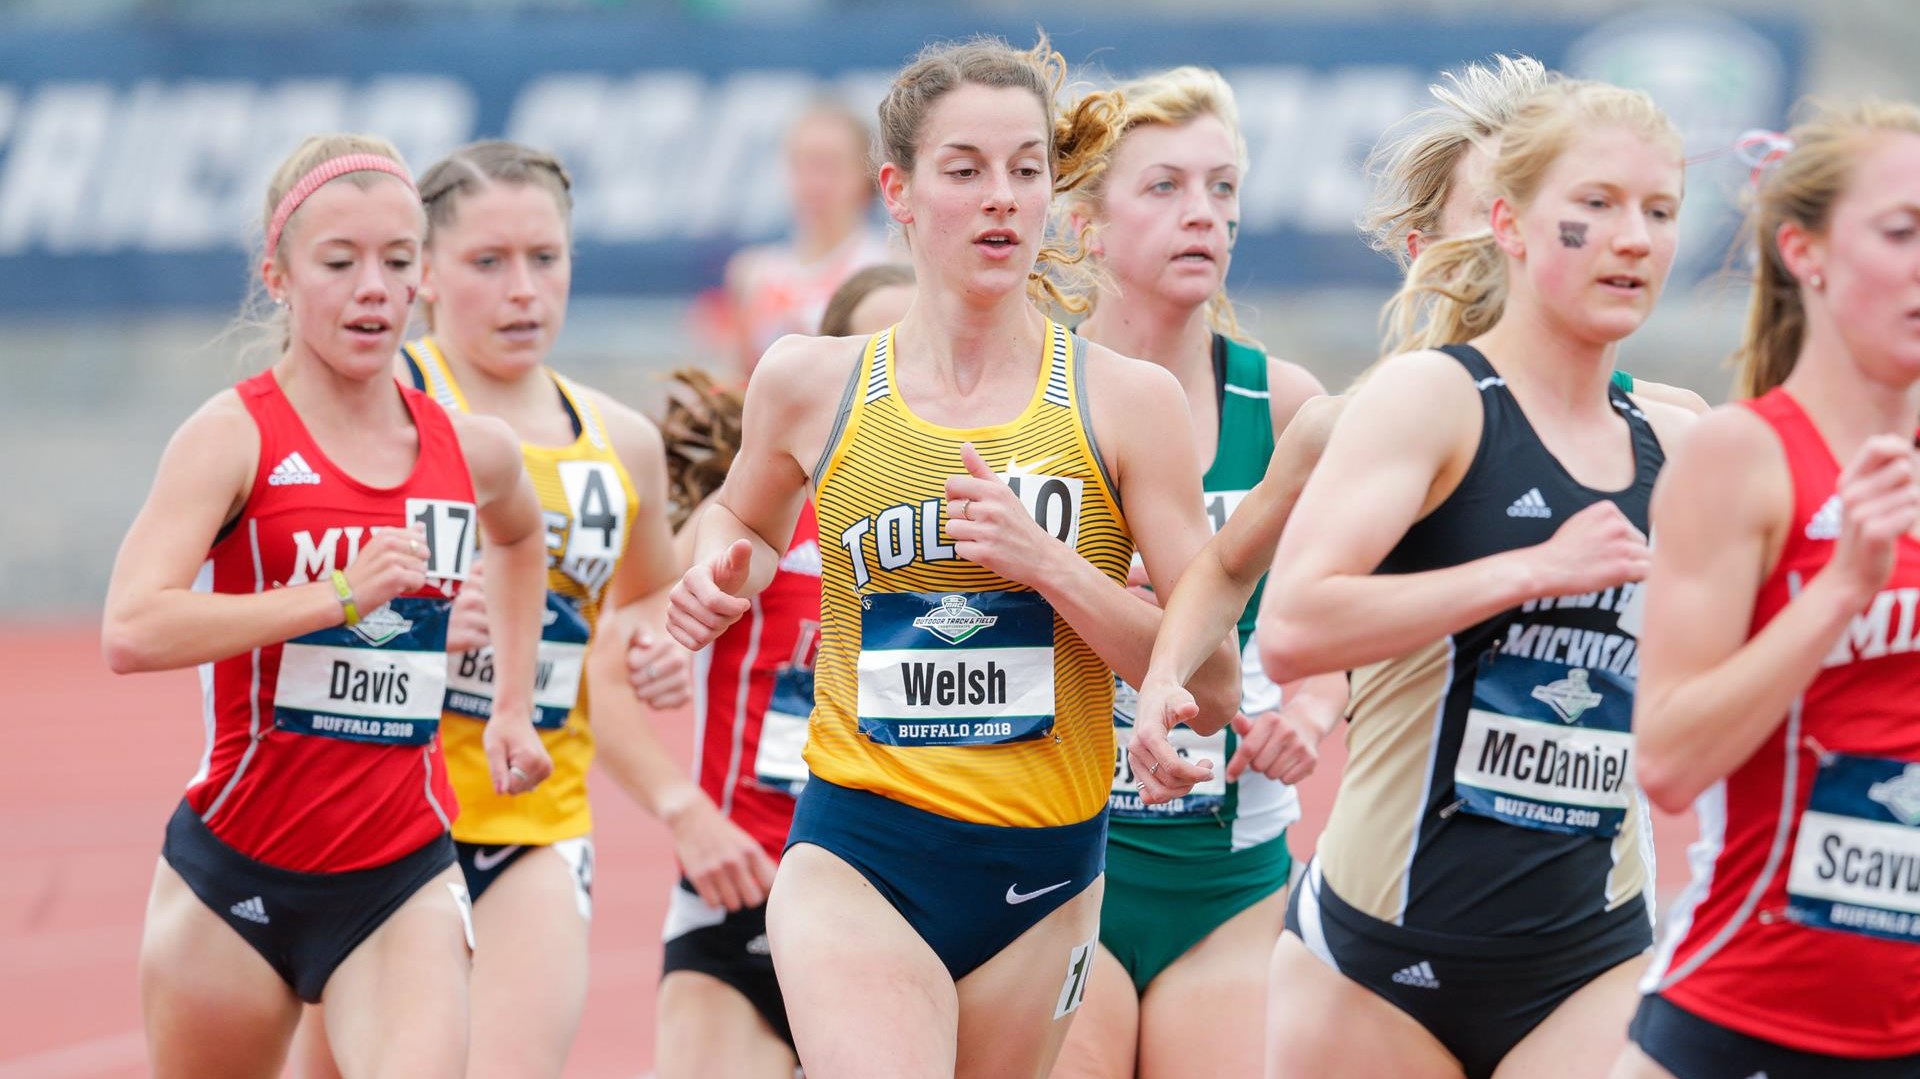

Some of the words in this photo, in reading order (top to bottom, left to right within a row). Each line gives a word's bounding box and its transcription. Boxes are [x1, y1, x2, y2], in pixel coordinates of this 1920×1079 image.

[268, 472, 321, 486] adidas
[580, 469, 617, 548] 4
[414, 504, 470, 574] 17
[840, 498, 957, 589] TOL
[946, 617, 969, 625] TRACK
[329, 660, 409, 705] Davis
[901, 661, 1006, 706] Welsh
[312, 715, 381, 736] BUFFALO
[381, 721, 414, 737] 2018
[898, 724, 970, 738] BUFFALO
[974, 723, 1011, 736] 2018
[1478, 729, 1628, 792] McDaniel
[1494, 797, 1565, 824] BUFFALO
[1565, 808, 1600, 827] 2018
